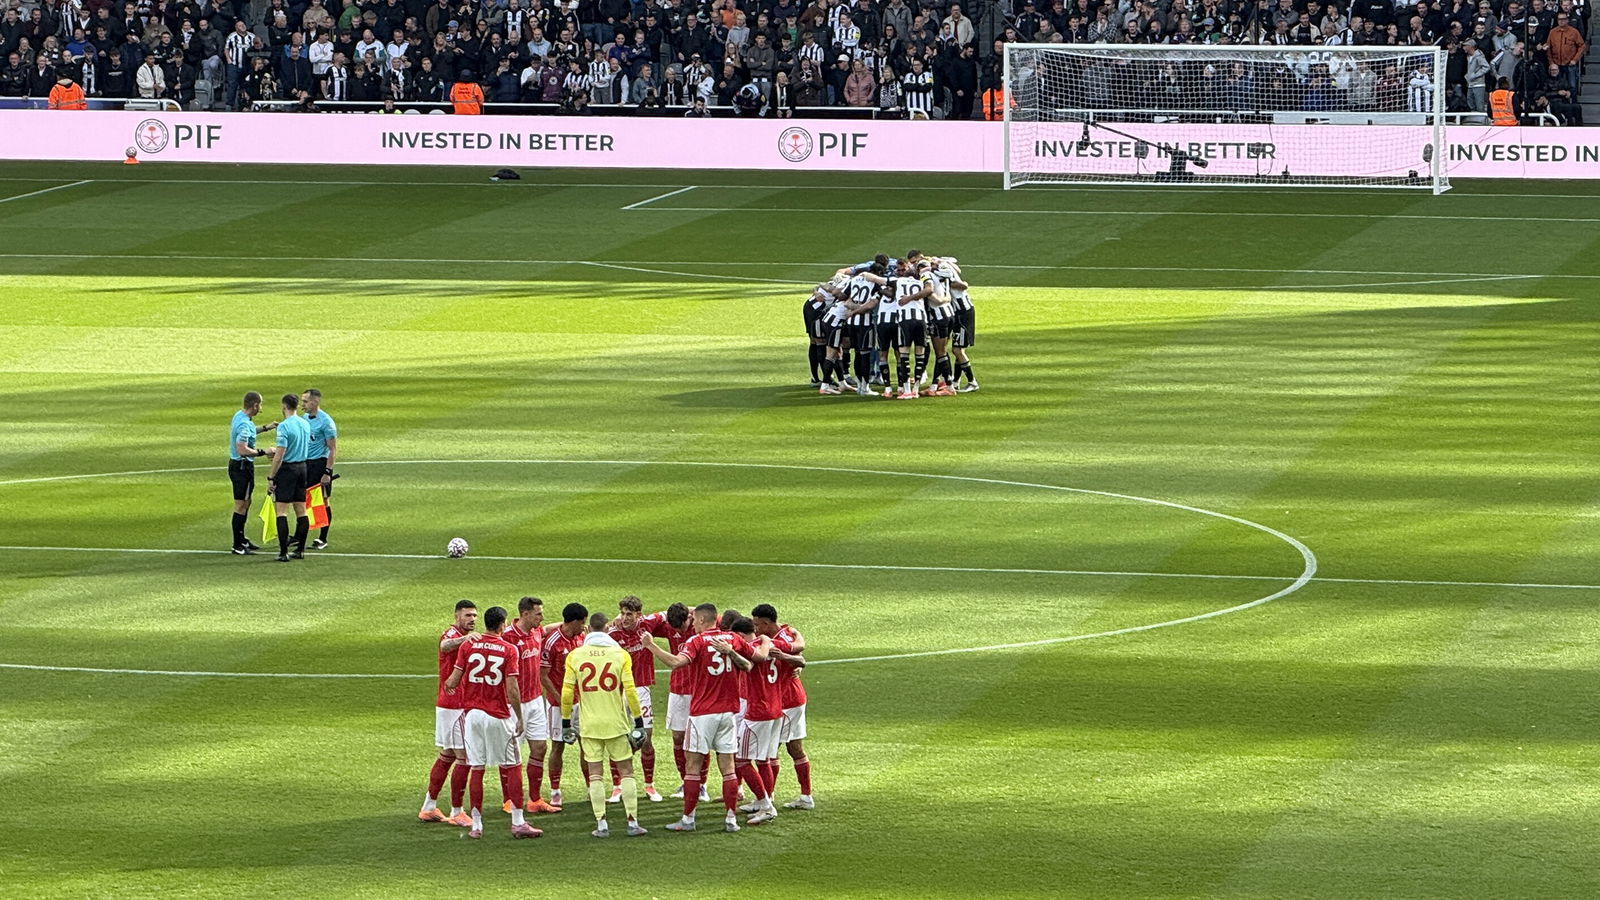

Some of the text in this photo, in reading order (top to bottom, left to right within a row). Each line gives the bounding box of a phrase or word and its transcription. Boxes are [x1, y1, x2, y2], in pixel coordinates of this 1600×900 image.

[174, 124, 222, 149] PIF
[382, 131, 614, 151] INVESTED IN BETTER
[818, 132, 869, 157] PIF
[1450, 144, 1599, 162] INVESTED IN
[851, 284, 870, 304] 20
[589, 649, 606, 657] SELS
[468, 653, 505, 686] 23
[579, 662, 618, 692] 26
